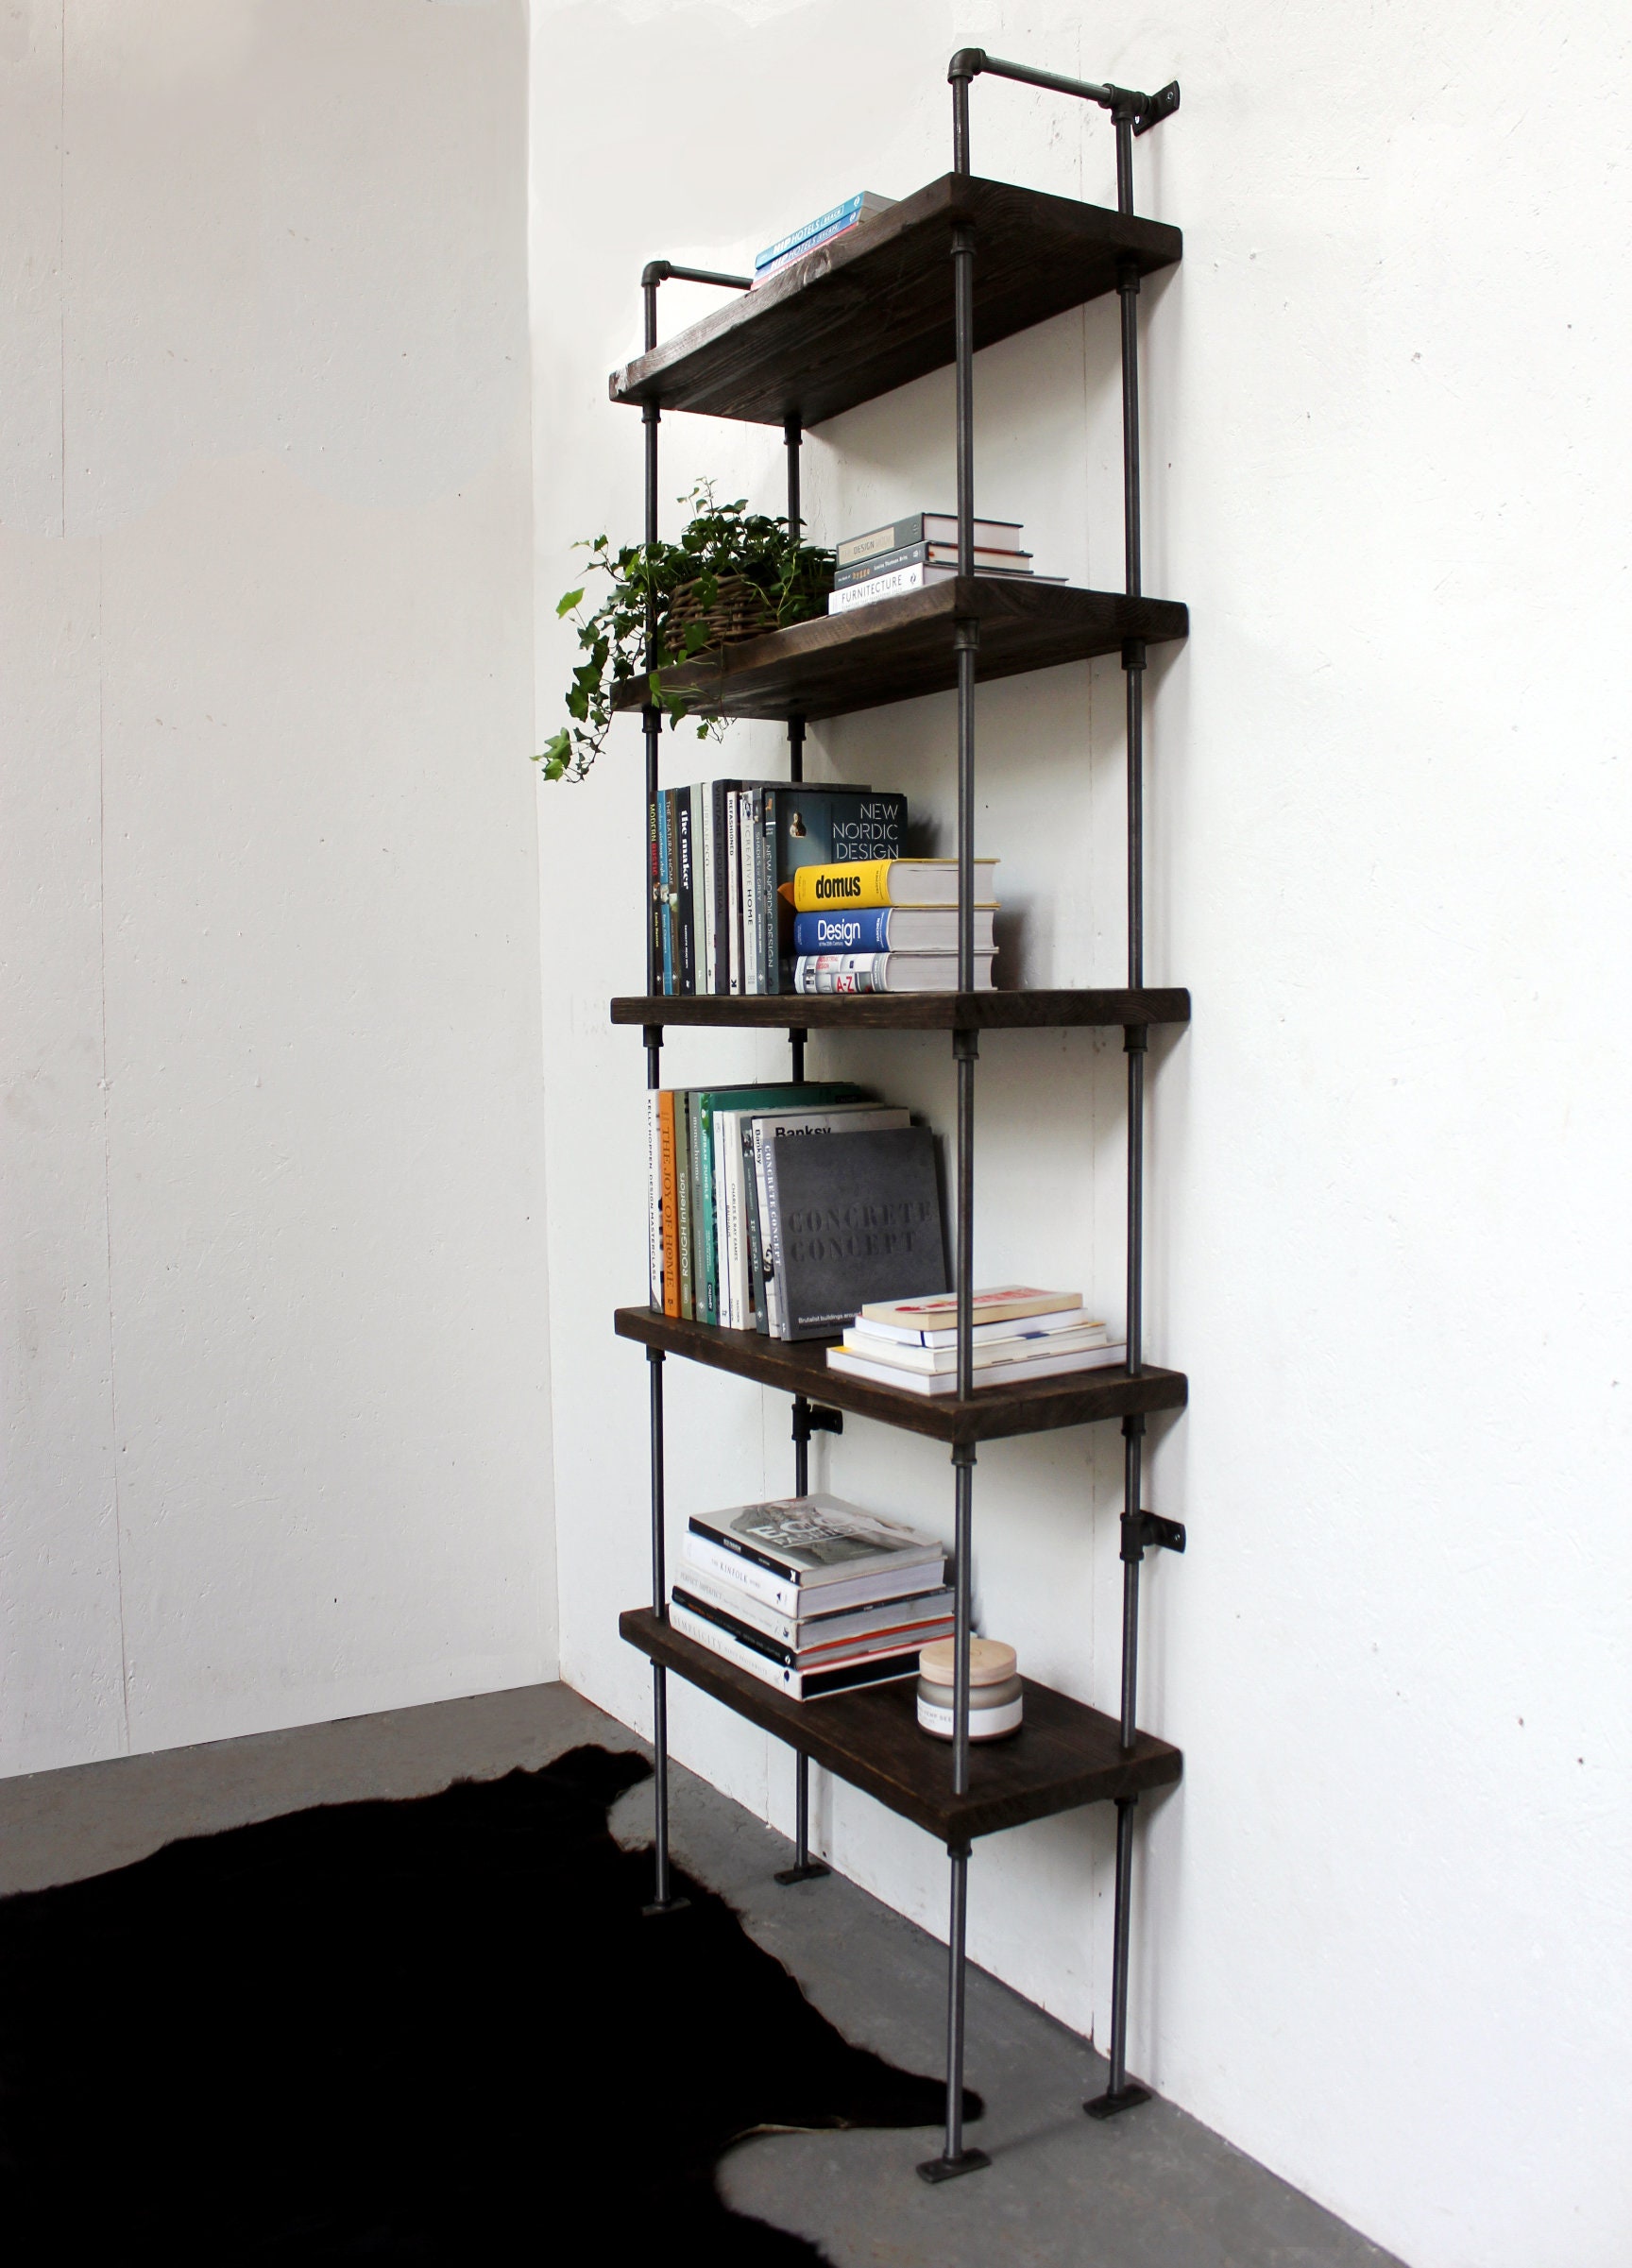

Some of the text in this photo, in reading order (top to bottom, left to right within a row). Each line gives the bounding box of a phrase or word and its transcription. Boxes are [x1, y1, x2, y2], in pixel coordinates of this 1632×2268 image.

[791, 220, 821, 245] HOTELS
[789, 237, 817, 259] HOTELS
[853, 539, 875, 555] DESIGN
[842, 574, 902, 604] FURNITECTURE
[714, 784, 722, 839] VINTAGE
[860, 803, 898, 820] NEW
[833, 823, 898, 840] NORDIC
[682, 838, 690, 890] maker
[744, 829, 753, 886] CREATIVE
[836, 843, 898, 860] DESIGN
[815, 875, 861, 899] domus
[817, 918, 861, 946] Design
[836, 975, 855, 993] A-Z
[662, 1126, 674, 1288] THE JOY OF HOME
[764, 1145, 781, 1267] CONCRETE CONCEPT
[788, 1201, 931, 1233] CONCRETE
[790, 1231, 916, 1262] CONCEPT
[720, 1562, 747, 1584] KINFOLK
[673, 1615, 722, 1650] SIMPLICITY
